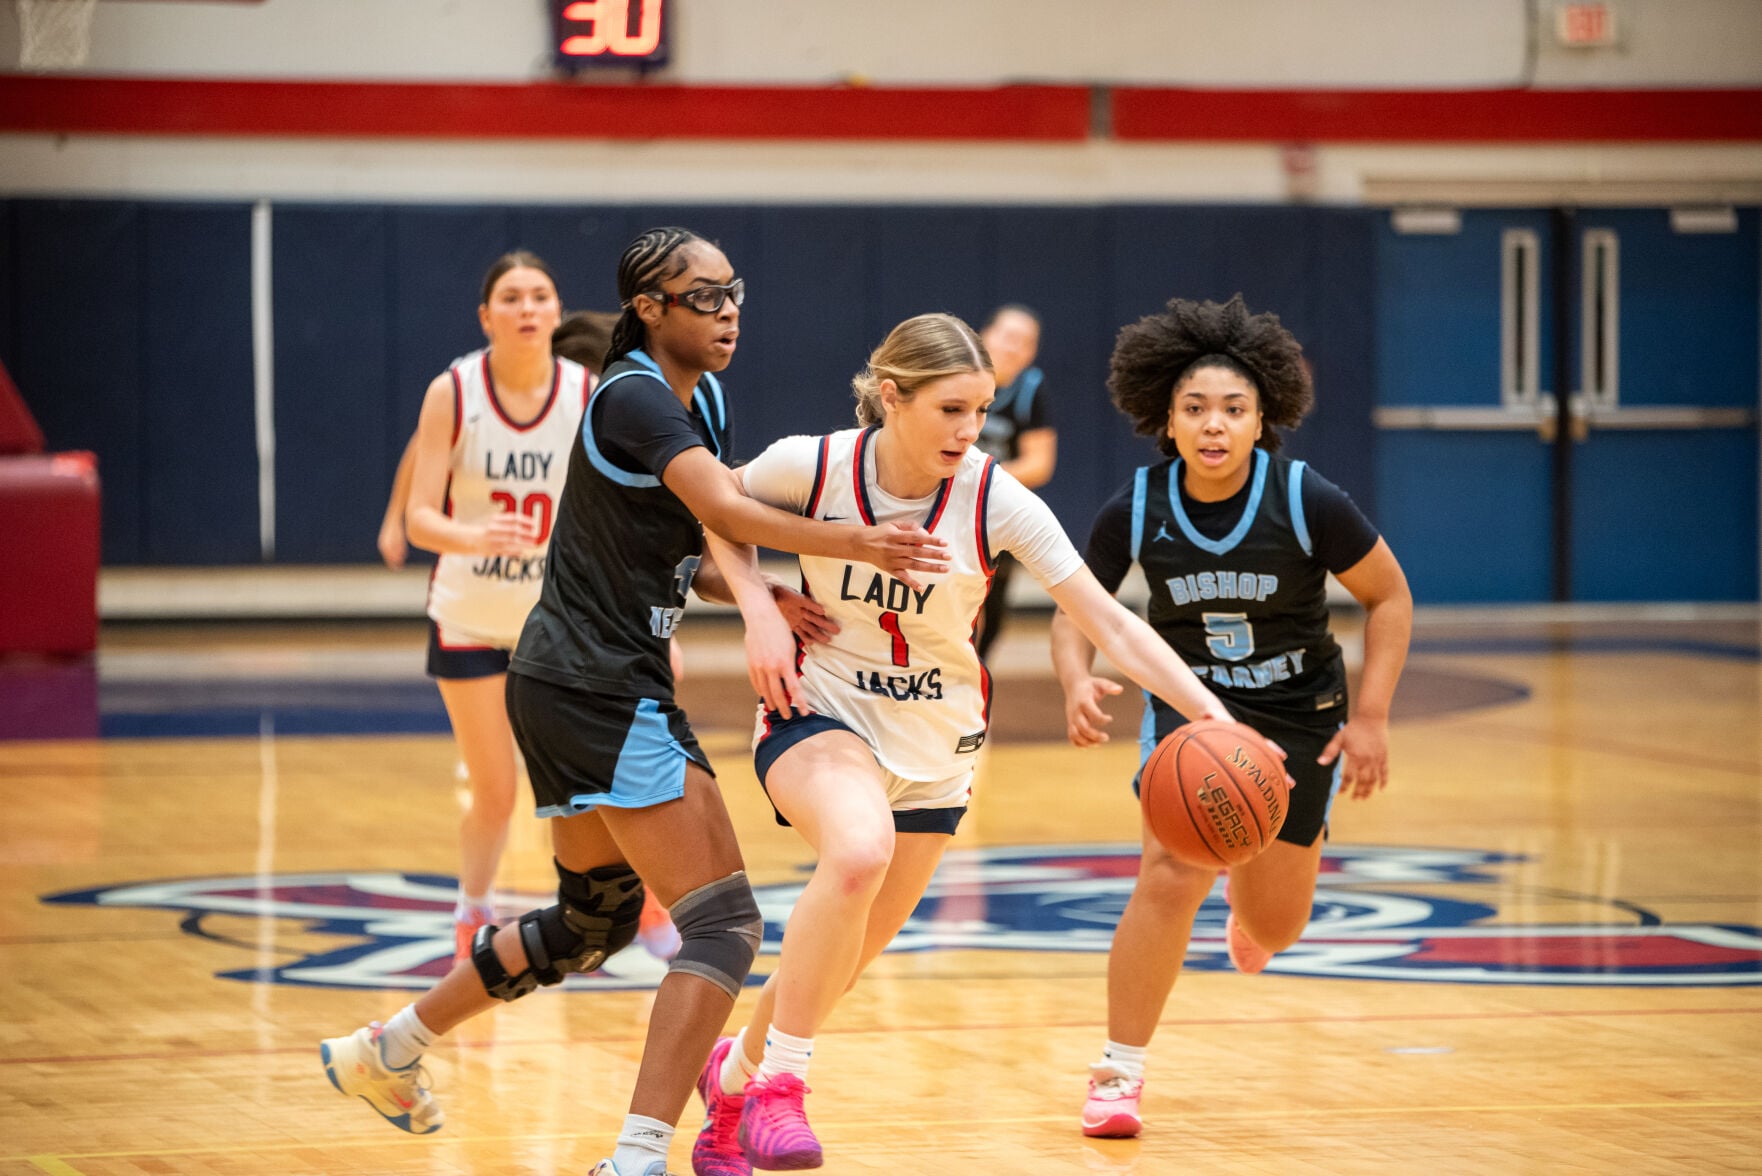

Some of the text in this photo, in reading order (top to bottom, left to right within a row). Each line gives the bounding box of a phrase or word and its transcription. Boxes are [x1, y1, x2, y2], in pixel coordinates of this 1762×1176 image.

[560, 0, 663, 56] 30
[486, 452, 552, 480] LADY
[840, 564, 935, 614] LADY
[1165, 570, 1278, 606] BISHOP
[878, 611, 909, 667] 1
[1202, 612, 1255, 661] 5
[856, 668, 943, 701] JACKS
[1190, 648, 1306, 689] ARNEY
[1203, 772, 1253, 847] LEGACY
